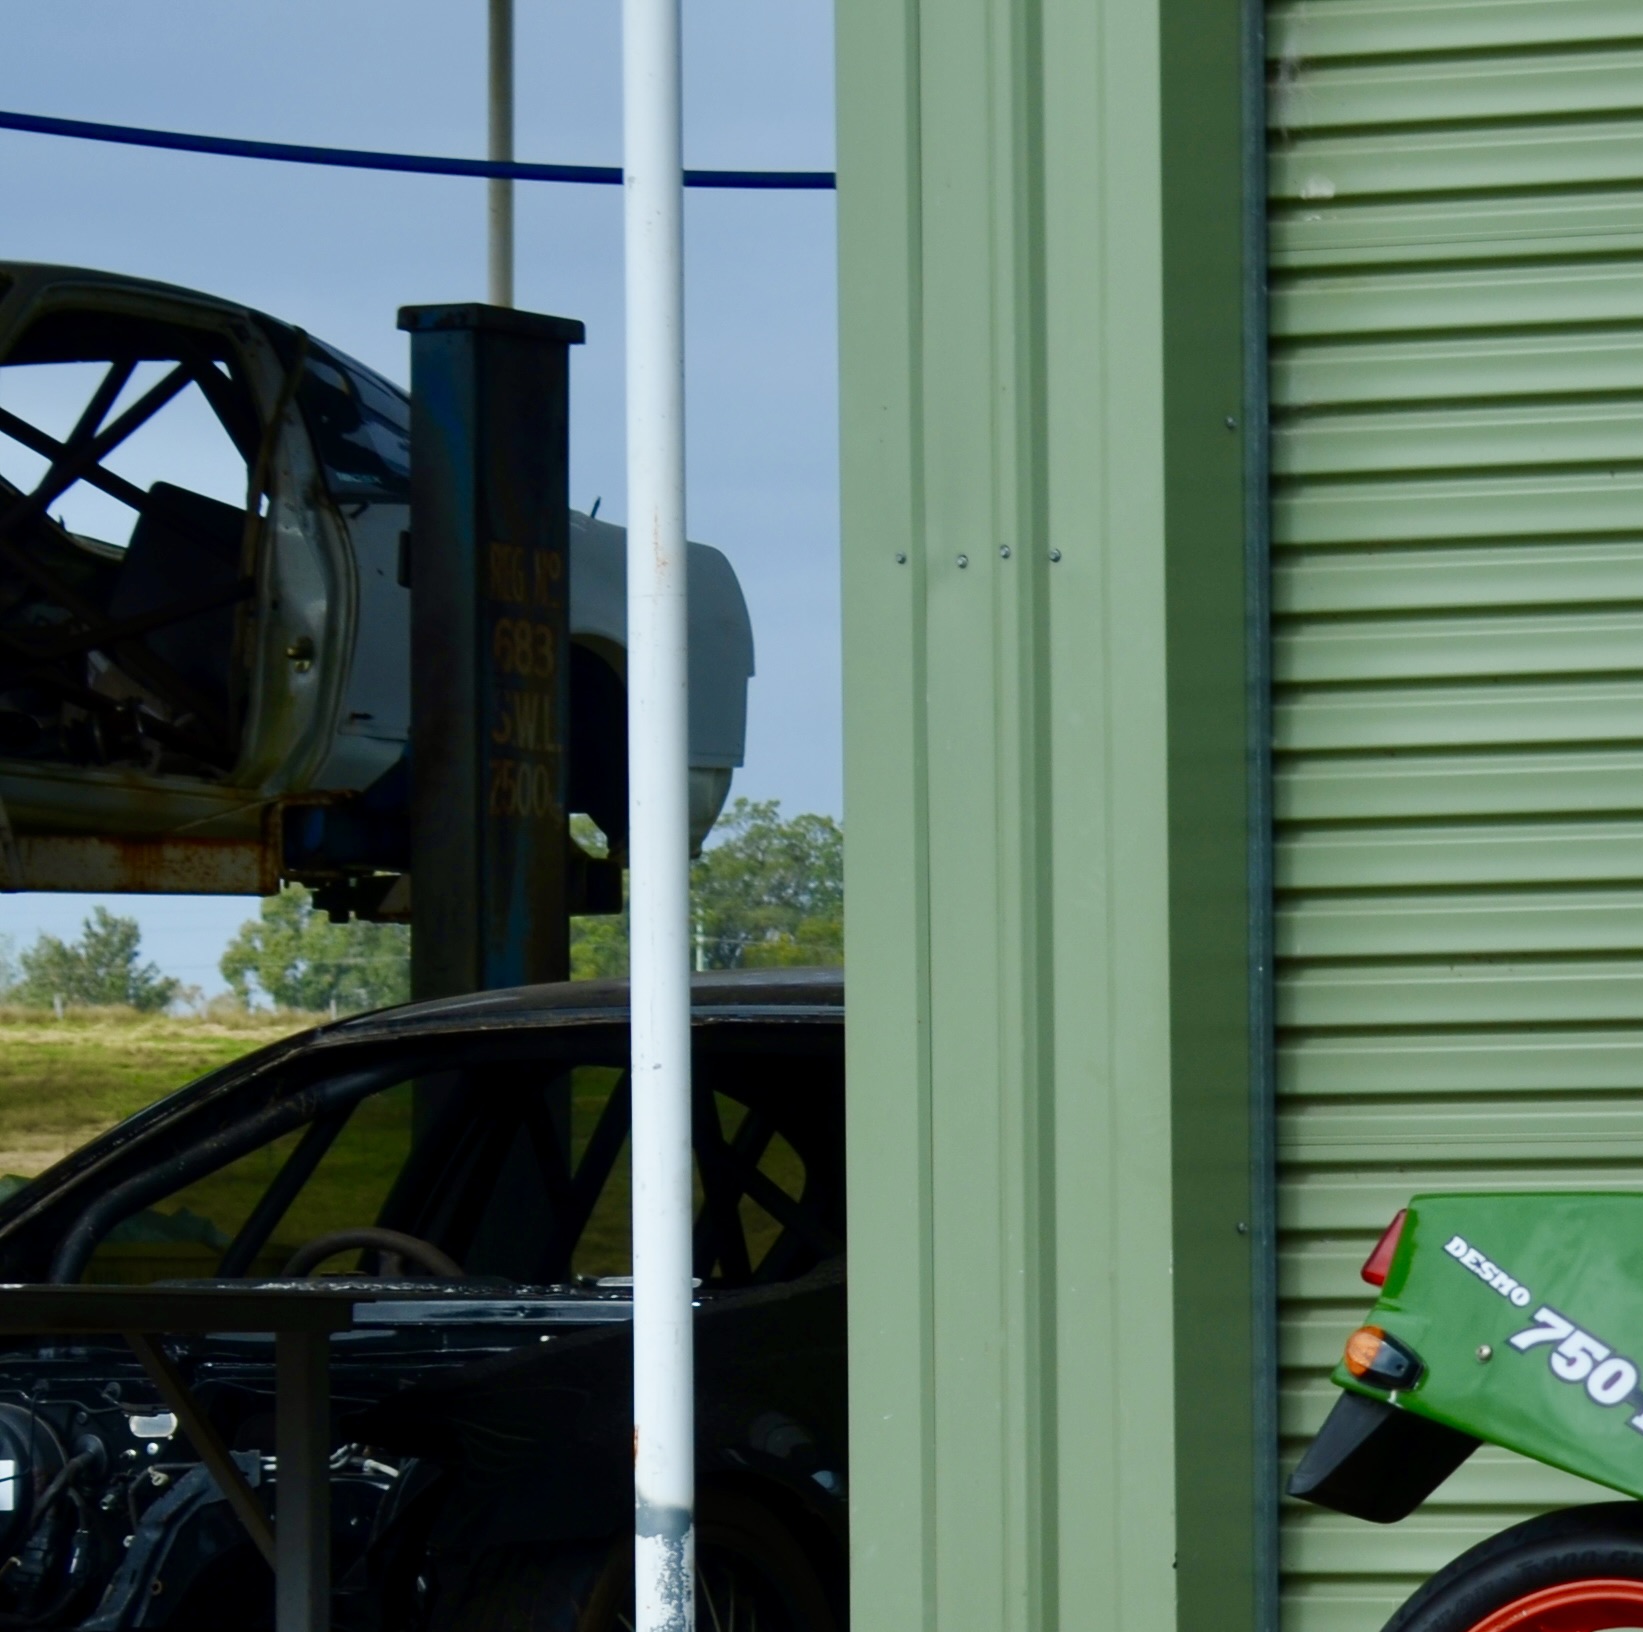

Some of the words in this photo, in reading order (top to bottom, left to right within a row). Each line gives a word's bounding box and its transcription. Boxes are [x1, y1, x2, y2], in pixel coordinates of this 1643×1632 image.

[495, 616, 554, 679] 683
[1443, 1234, 1532, 1307] DESMO
[1508, 1305, 1639, 1405] 750
